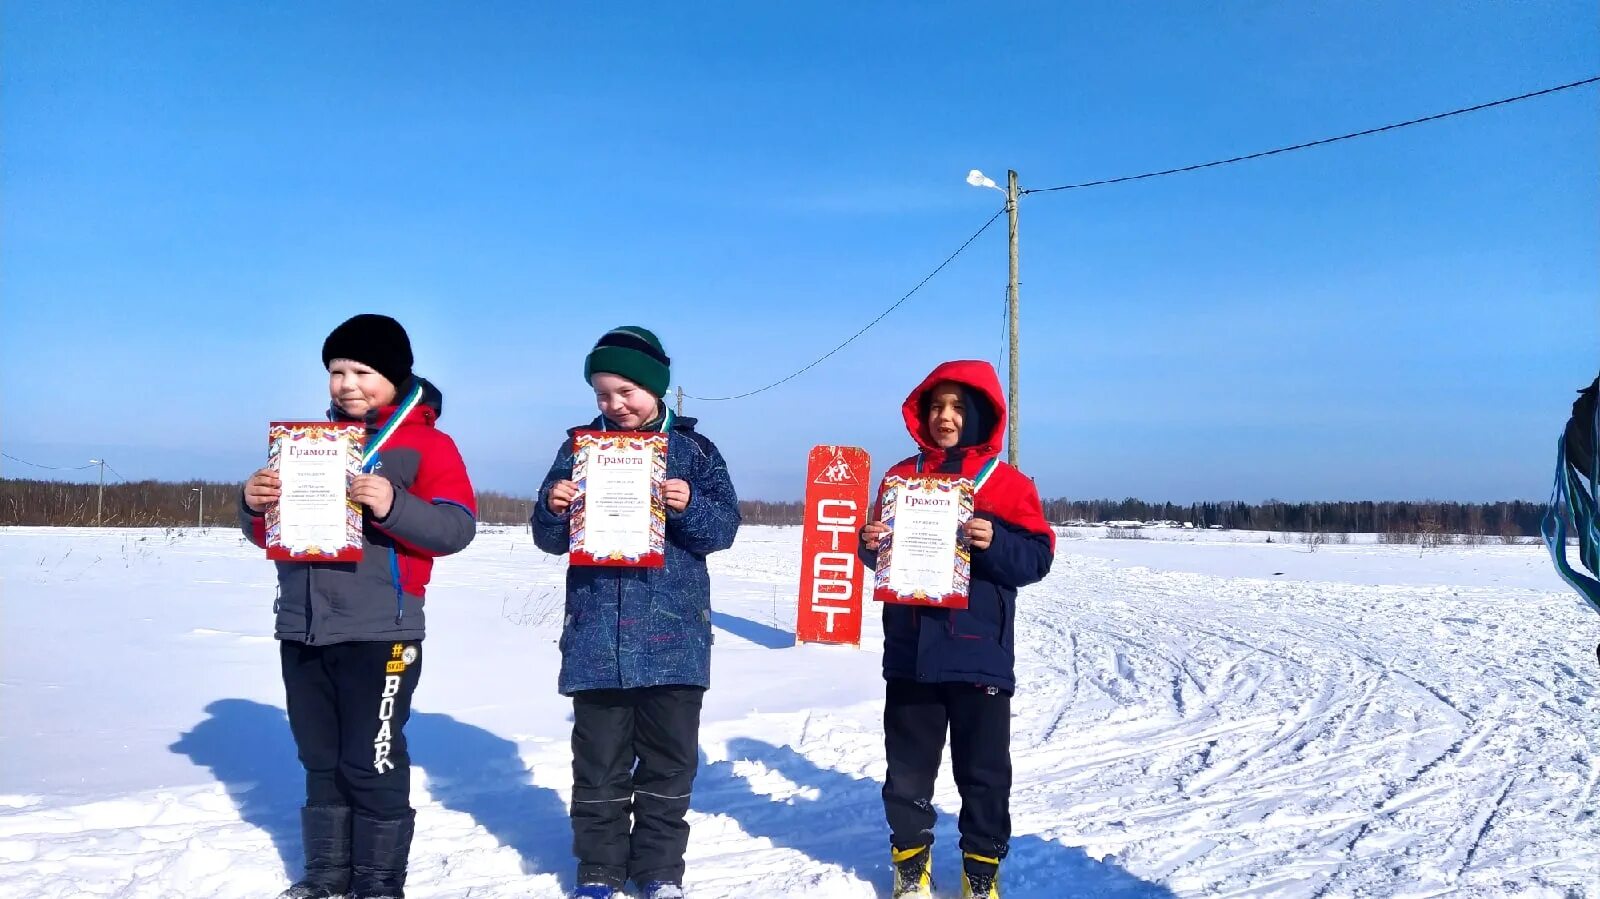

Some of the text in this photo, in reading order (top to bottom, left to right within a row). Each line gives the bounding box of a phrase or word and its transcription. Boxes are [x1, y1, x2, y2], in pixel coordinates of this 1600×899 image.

[289, 445, 338, 458] Грамота
[597, 454, 643, 466] Грамота
[905, 495, 951, 507] Грамота
[811, 498, 858, 633] СТАРТ
